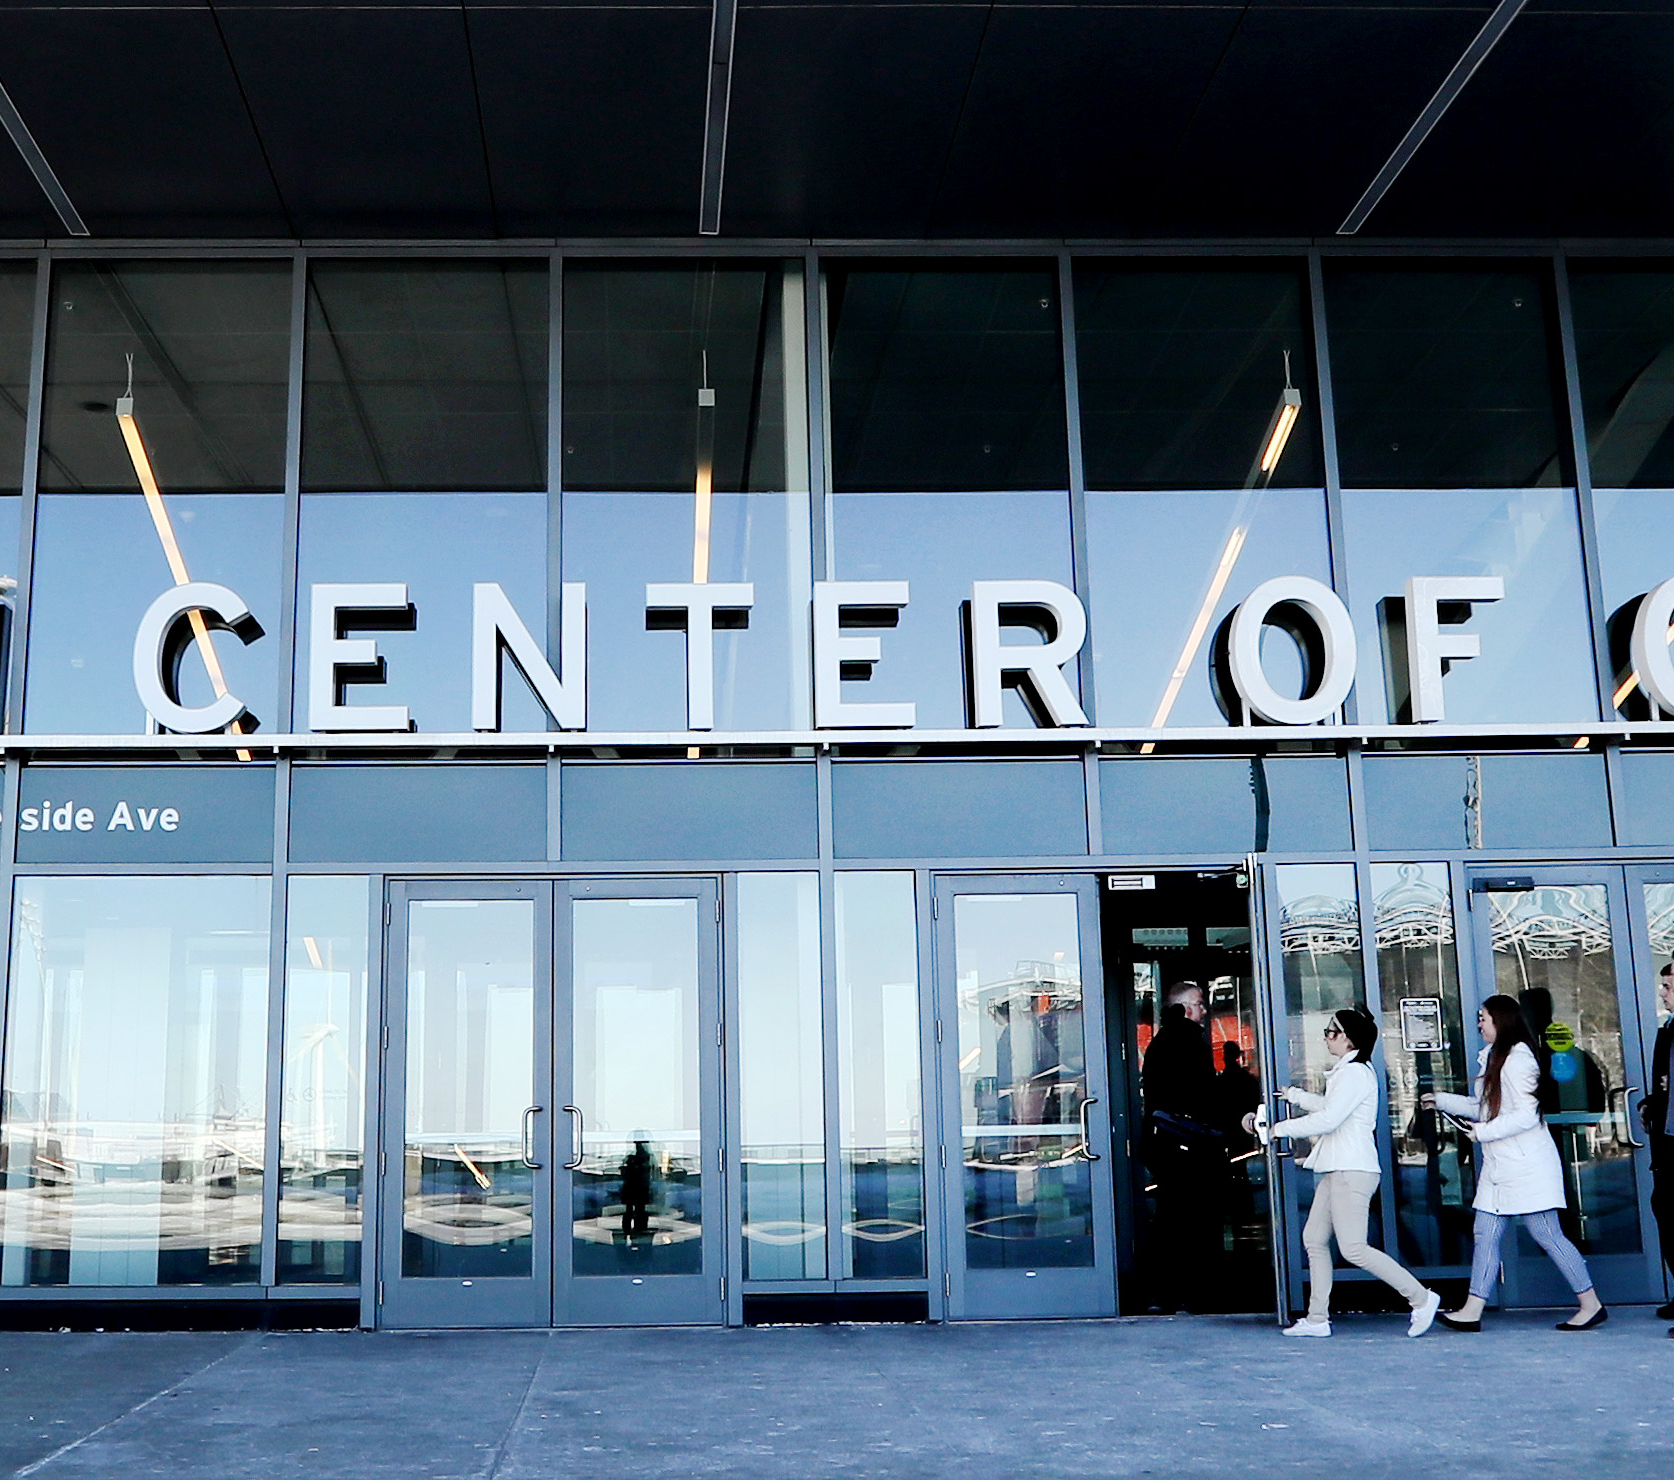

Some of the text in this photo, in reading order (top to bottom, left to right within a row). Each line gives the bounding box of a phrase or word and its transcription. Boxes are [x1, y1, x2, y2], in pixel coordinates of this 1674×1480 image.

[133, 579, 1090, 735] CENTER
[1227, 575, 1505, 727] OF
[107, 801, 180, 832] Ave
